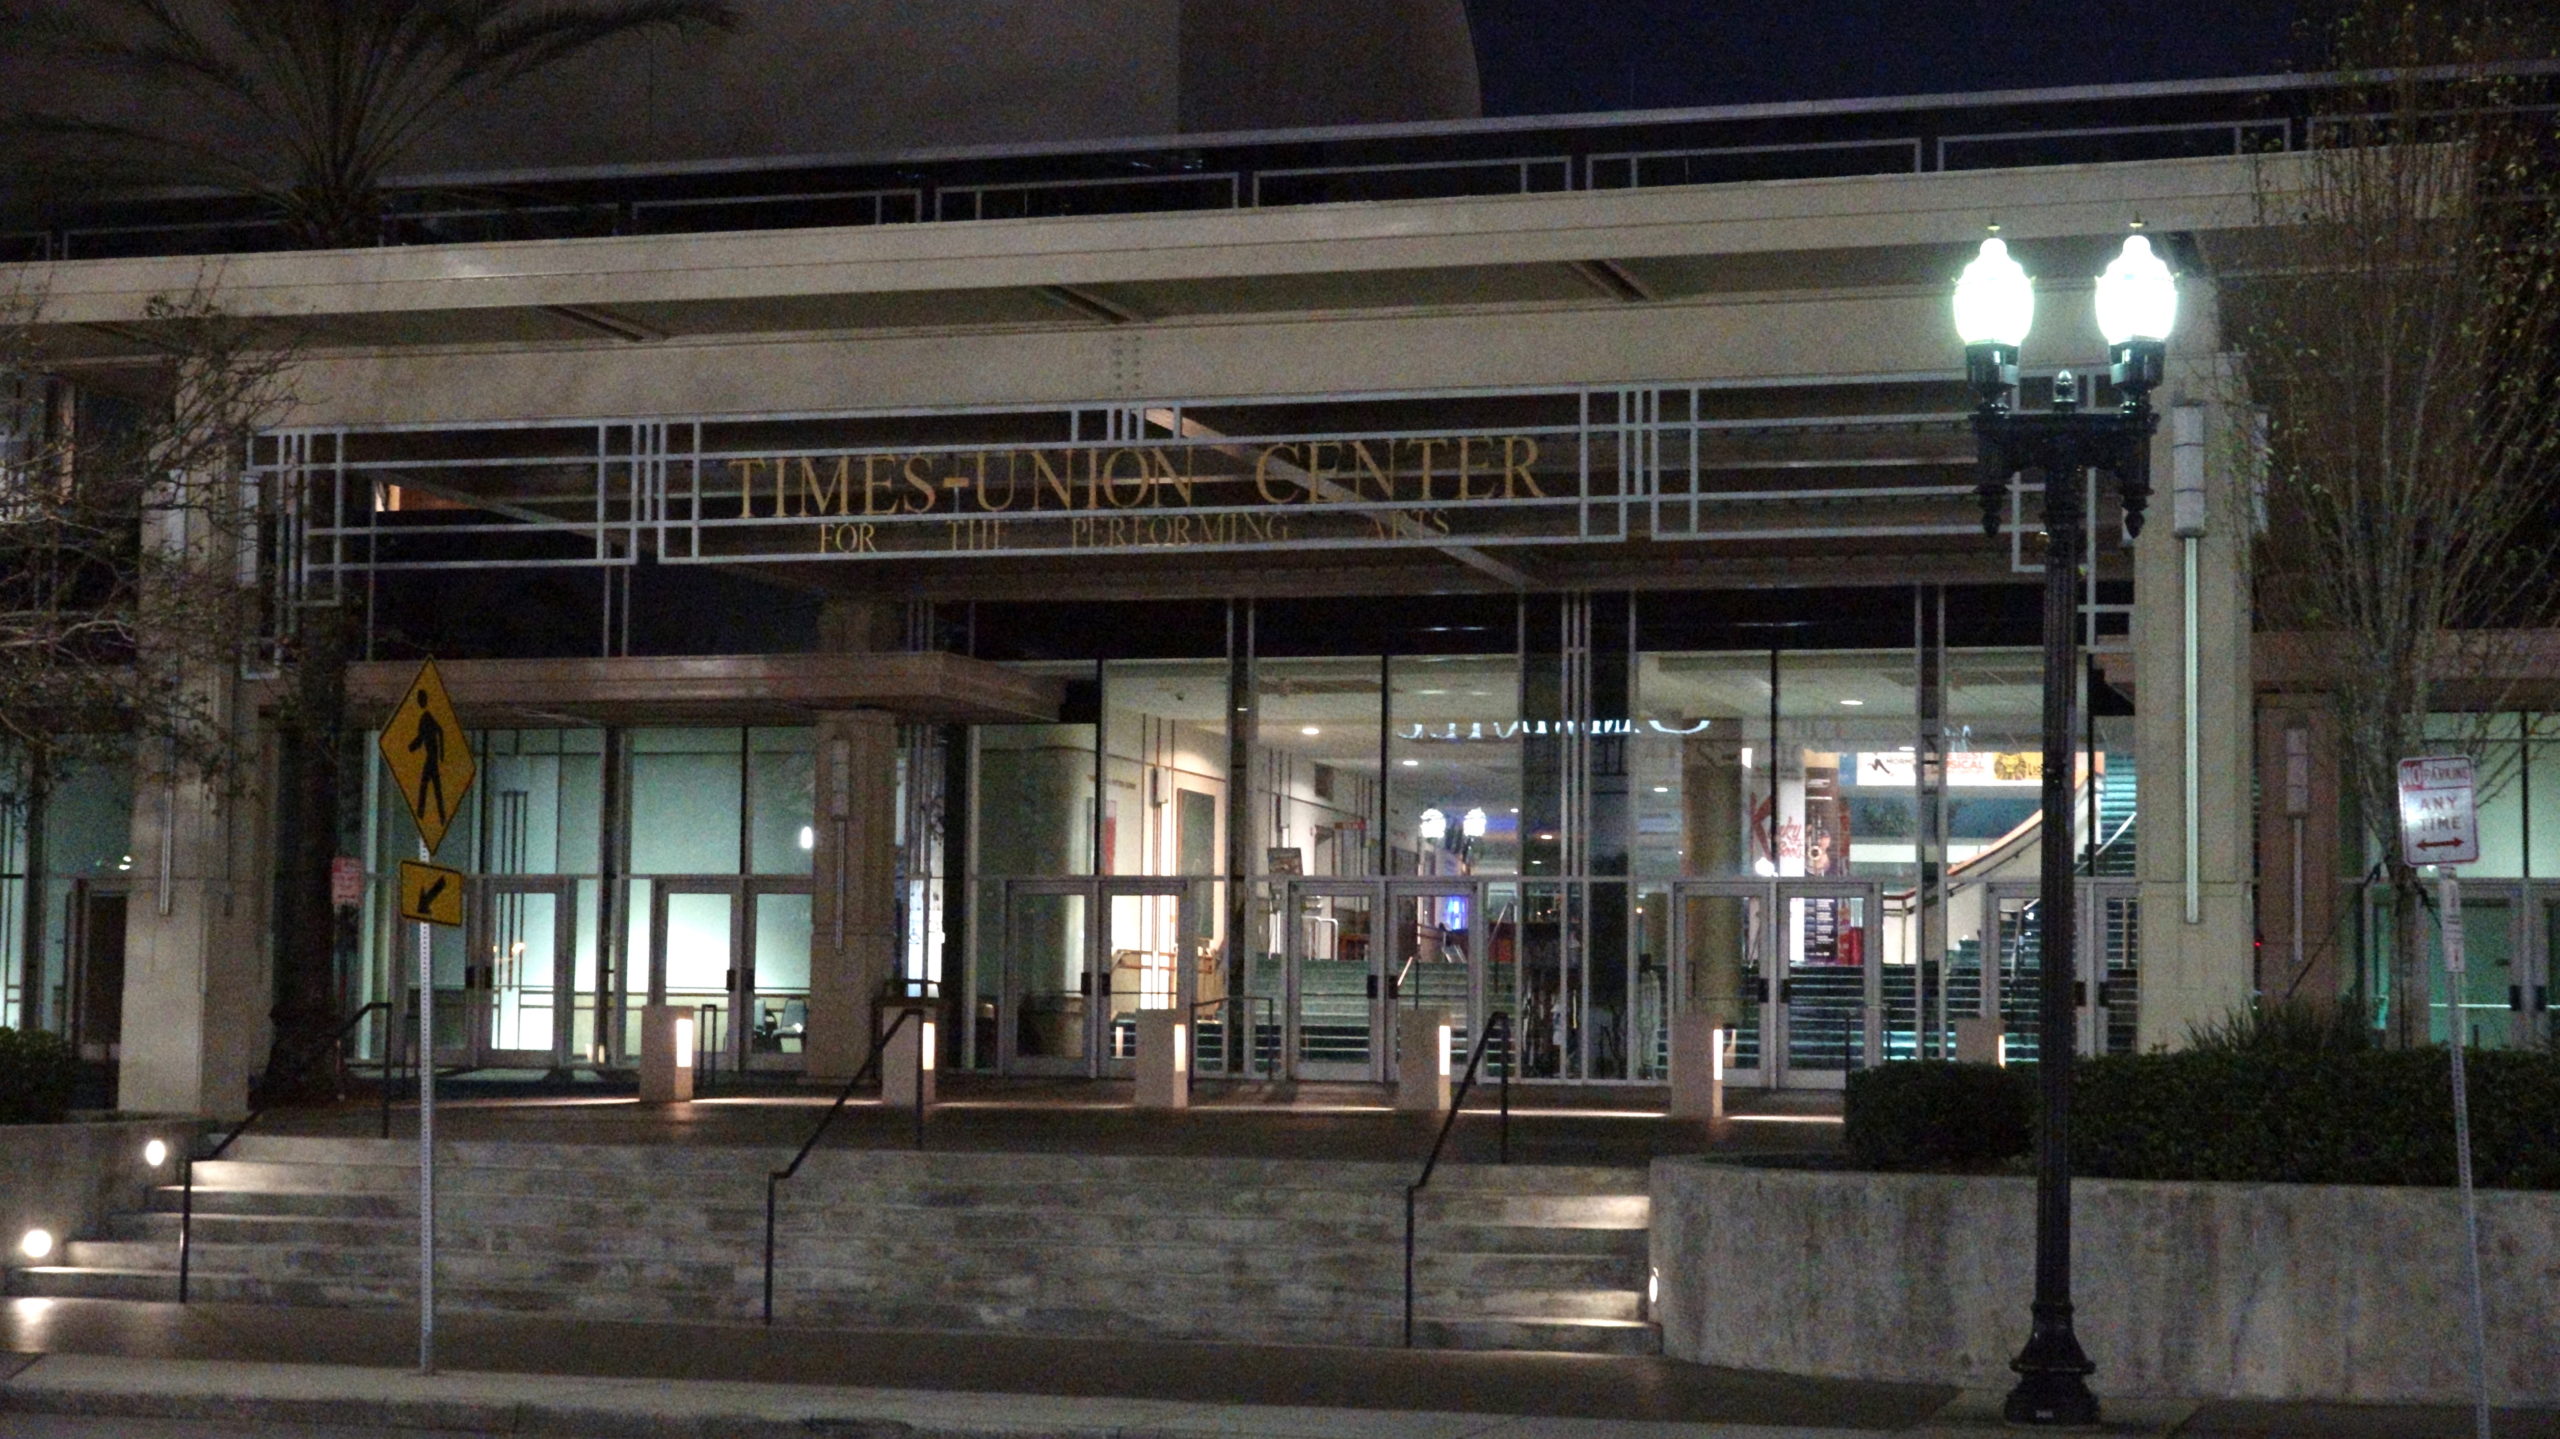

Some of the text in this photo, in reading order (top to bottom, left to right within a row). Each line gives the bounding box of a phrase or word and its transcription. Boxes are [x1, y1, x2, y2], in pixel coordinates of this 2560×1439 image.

[728, 435, 1547, 519] TIMES-UNION CENTER
[819, 508, 1450, 554] FOR THE PERFORMING ARTS
[2423, 766, 2470, 780] PARKING
[2420, 796, 2457, 810] ANY
[2420, 816, 2462, 832] TIME
